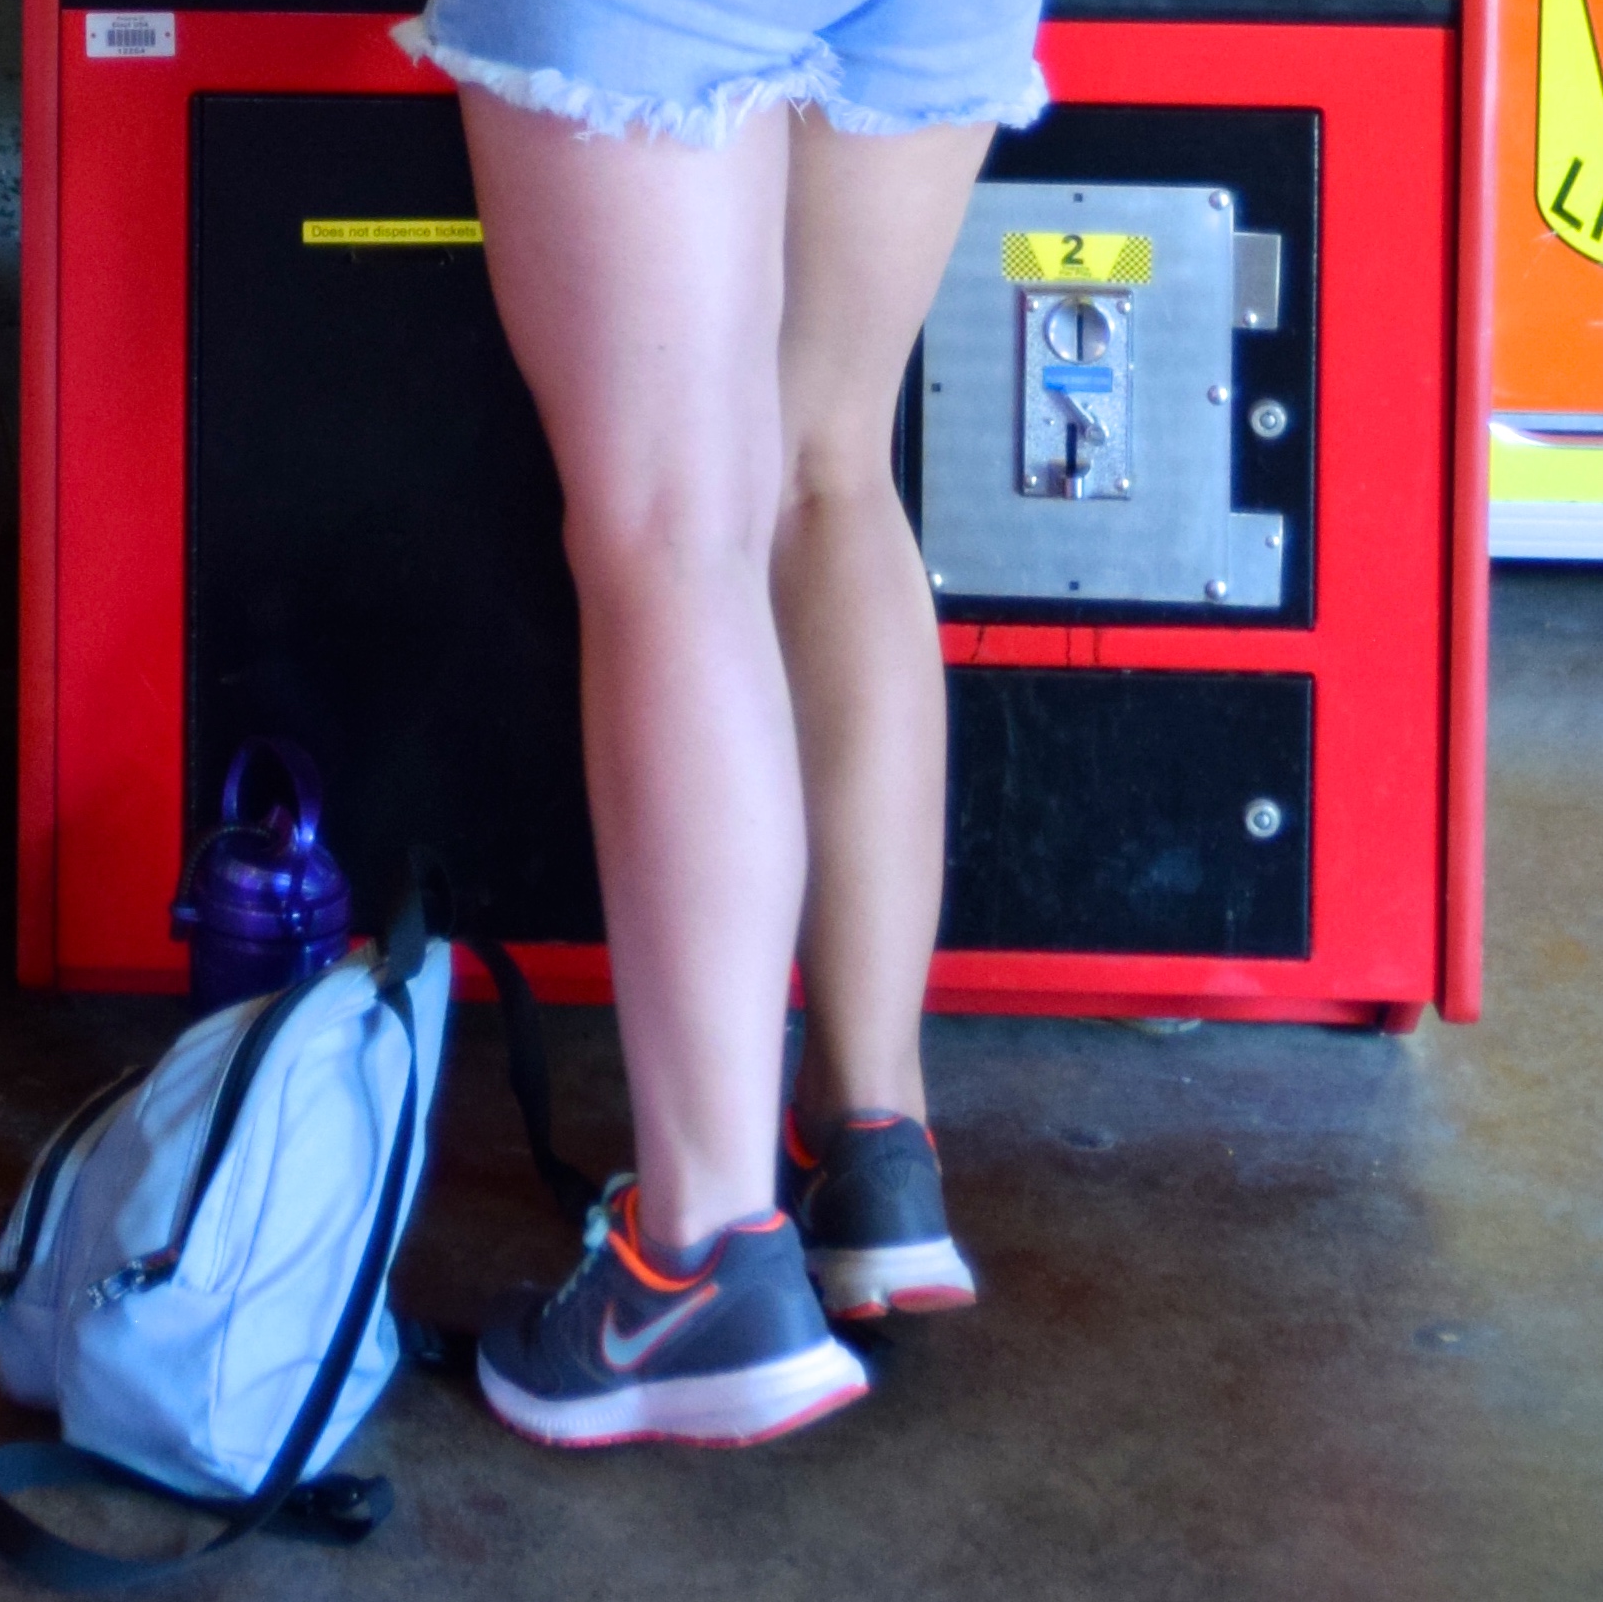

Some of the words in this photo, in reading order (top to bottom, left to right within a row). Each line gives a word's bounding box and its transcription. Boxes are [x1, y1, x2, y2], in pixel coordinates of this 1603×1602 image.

[311, 226, 344, 238] Does
[348, 226, 369, 238] not
[373, 226, 431, 240] dispence
[435, 226, 476, 237] tickets
[1061, 234, 1084, 265] 2
